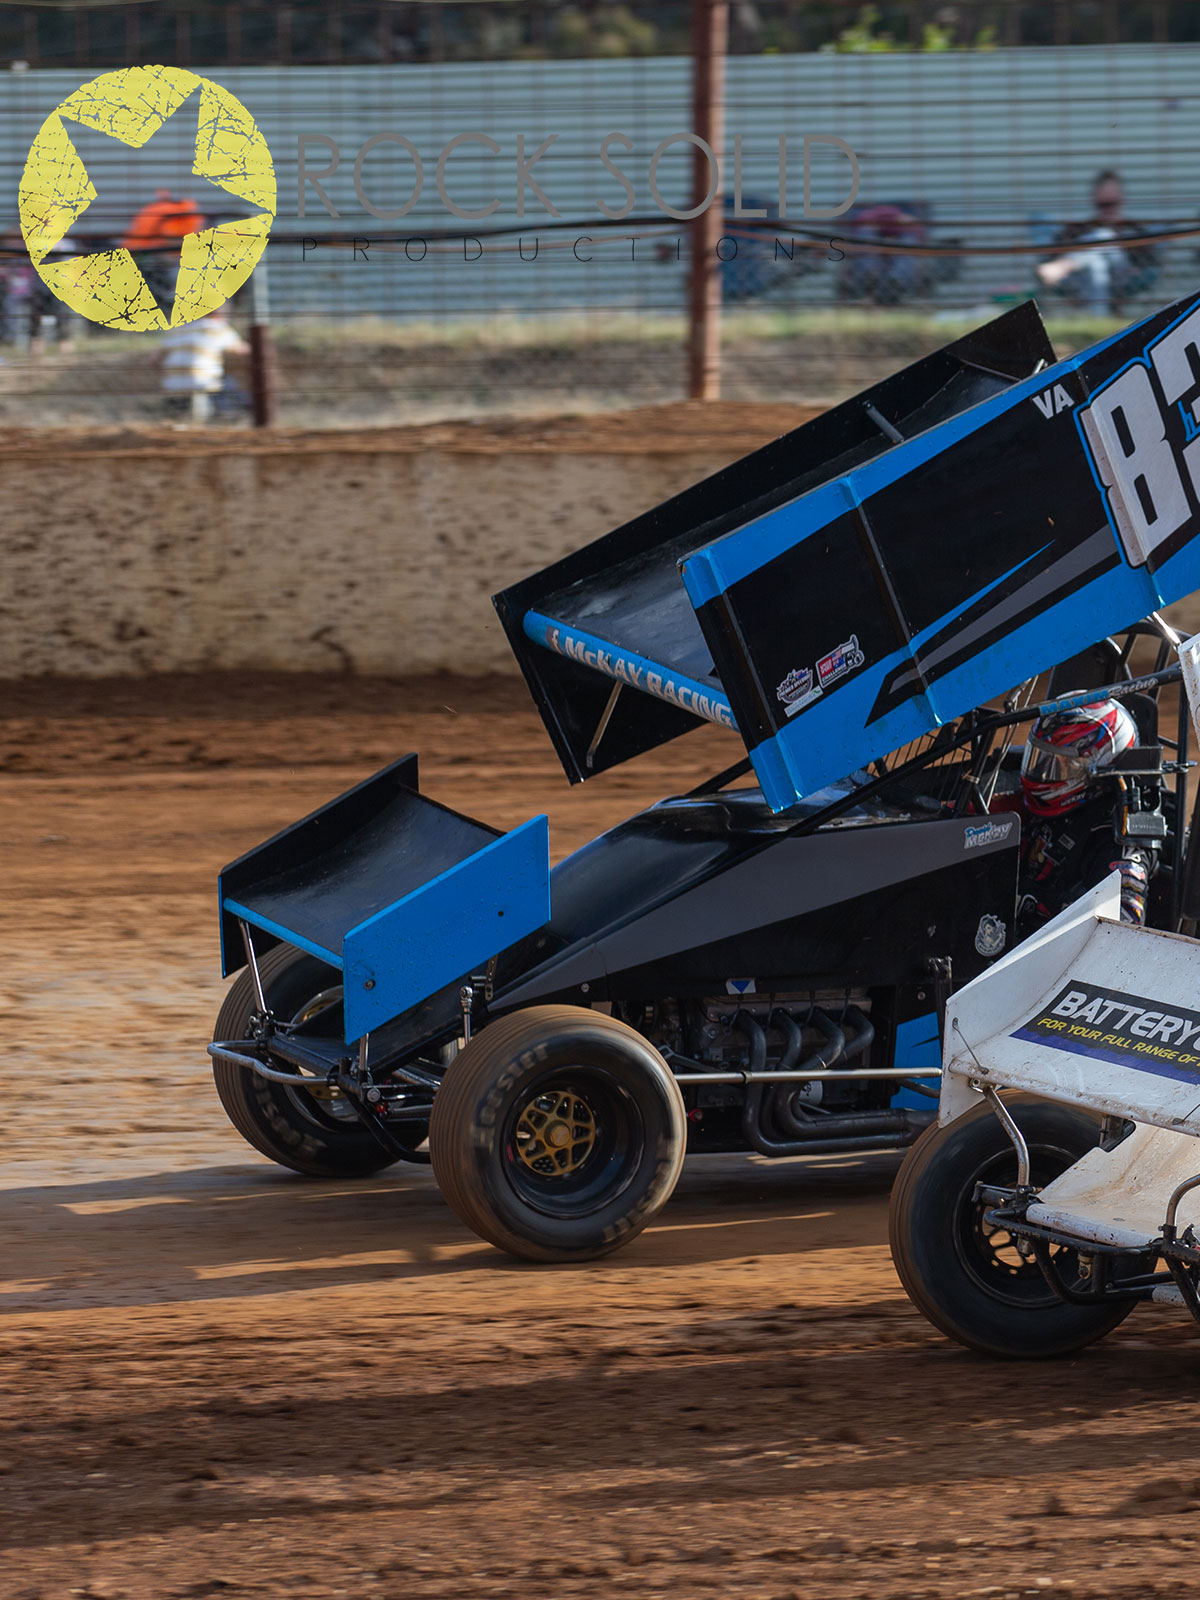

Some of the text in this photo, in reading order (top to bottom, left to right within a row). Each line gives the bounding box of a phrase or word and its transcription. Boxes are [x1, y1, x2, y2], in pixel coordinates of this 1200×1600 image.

[1032, 383, 1075, 420] VA
[564, 635, 644, 688] McKAY
[645, 670, 733, 727] RACING
[1038, 676, 1158, 714] MAXIM Racing
[1037, 1018, 1067, 1032] FOR
[1067, 1024, 1104, 1040] YOUR
[1100, 1033, 1130, 1049] FULL
[1132, 1042, 1180, 1060] RANGE
[1177, 1053, 1199, 1064] OF
